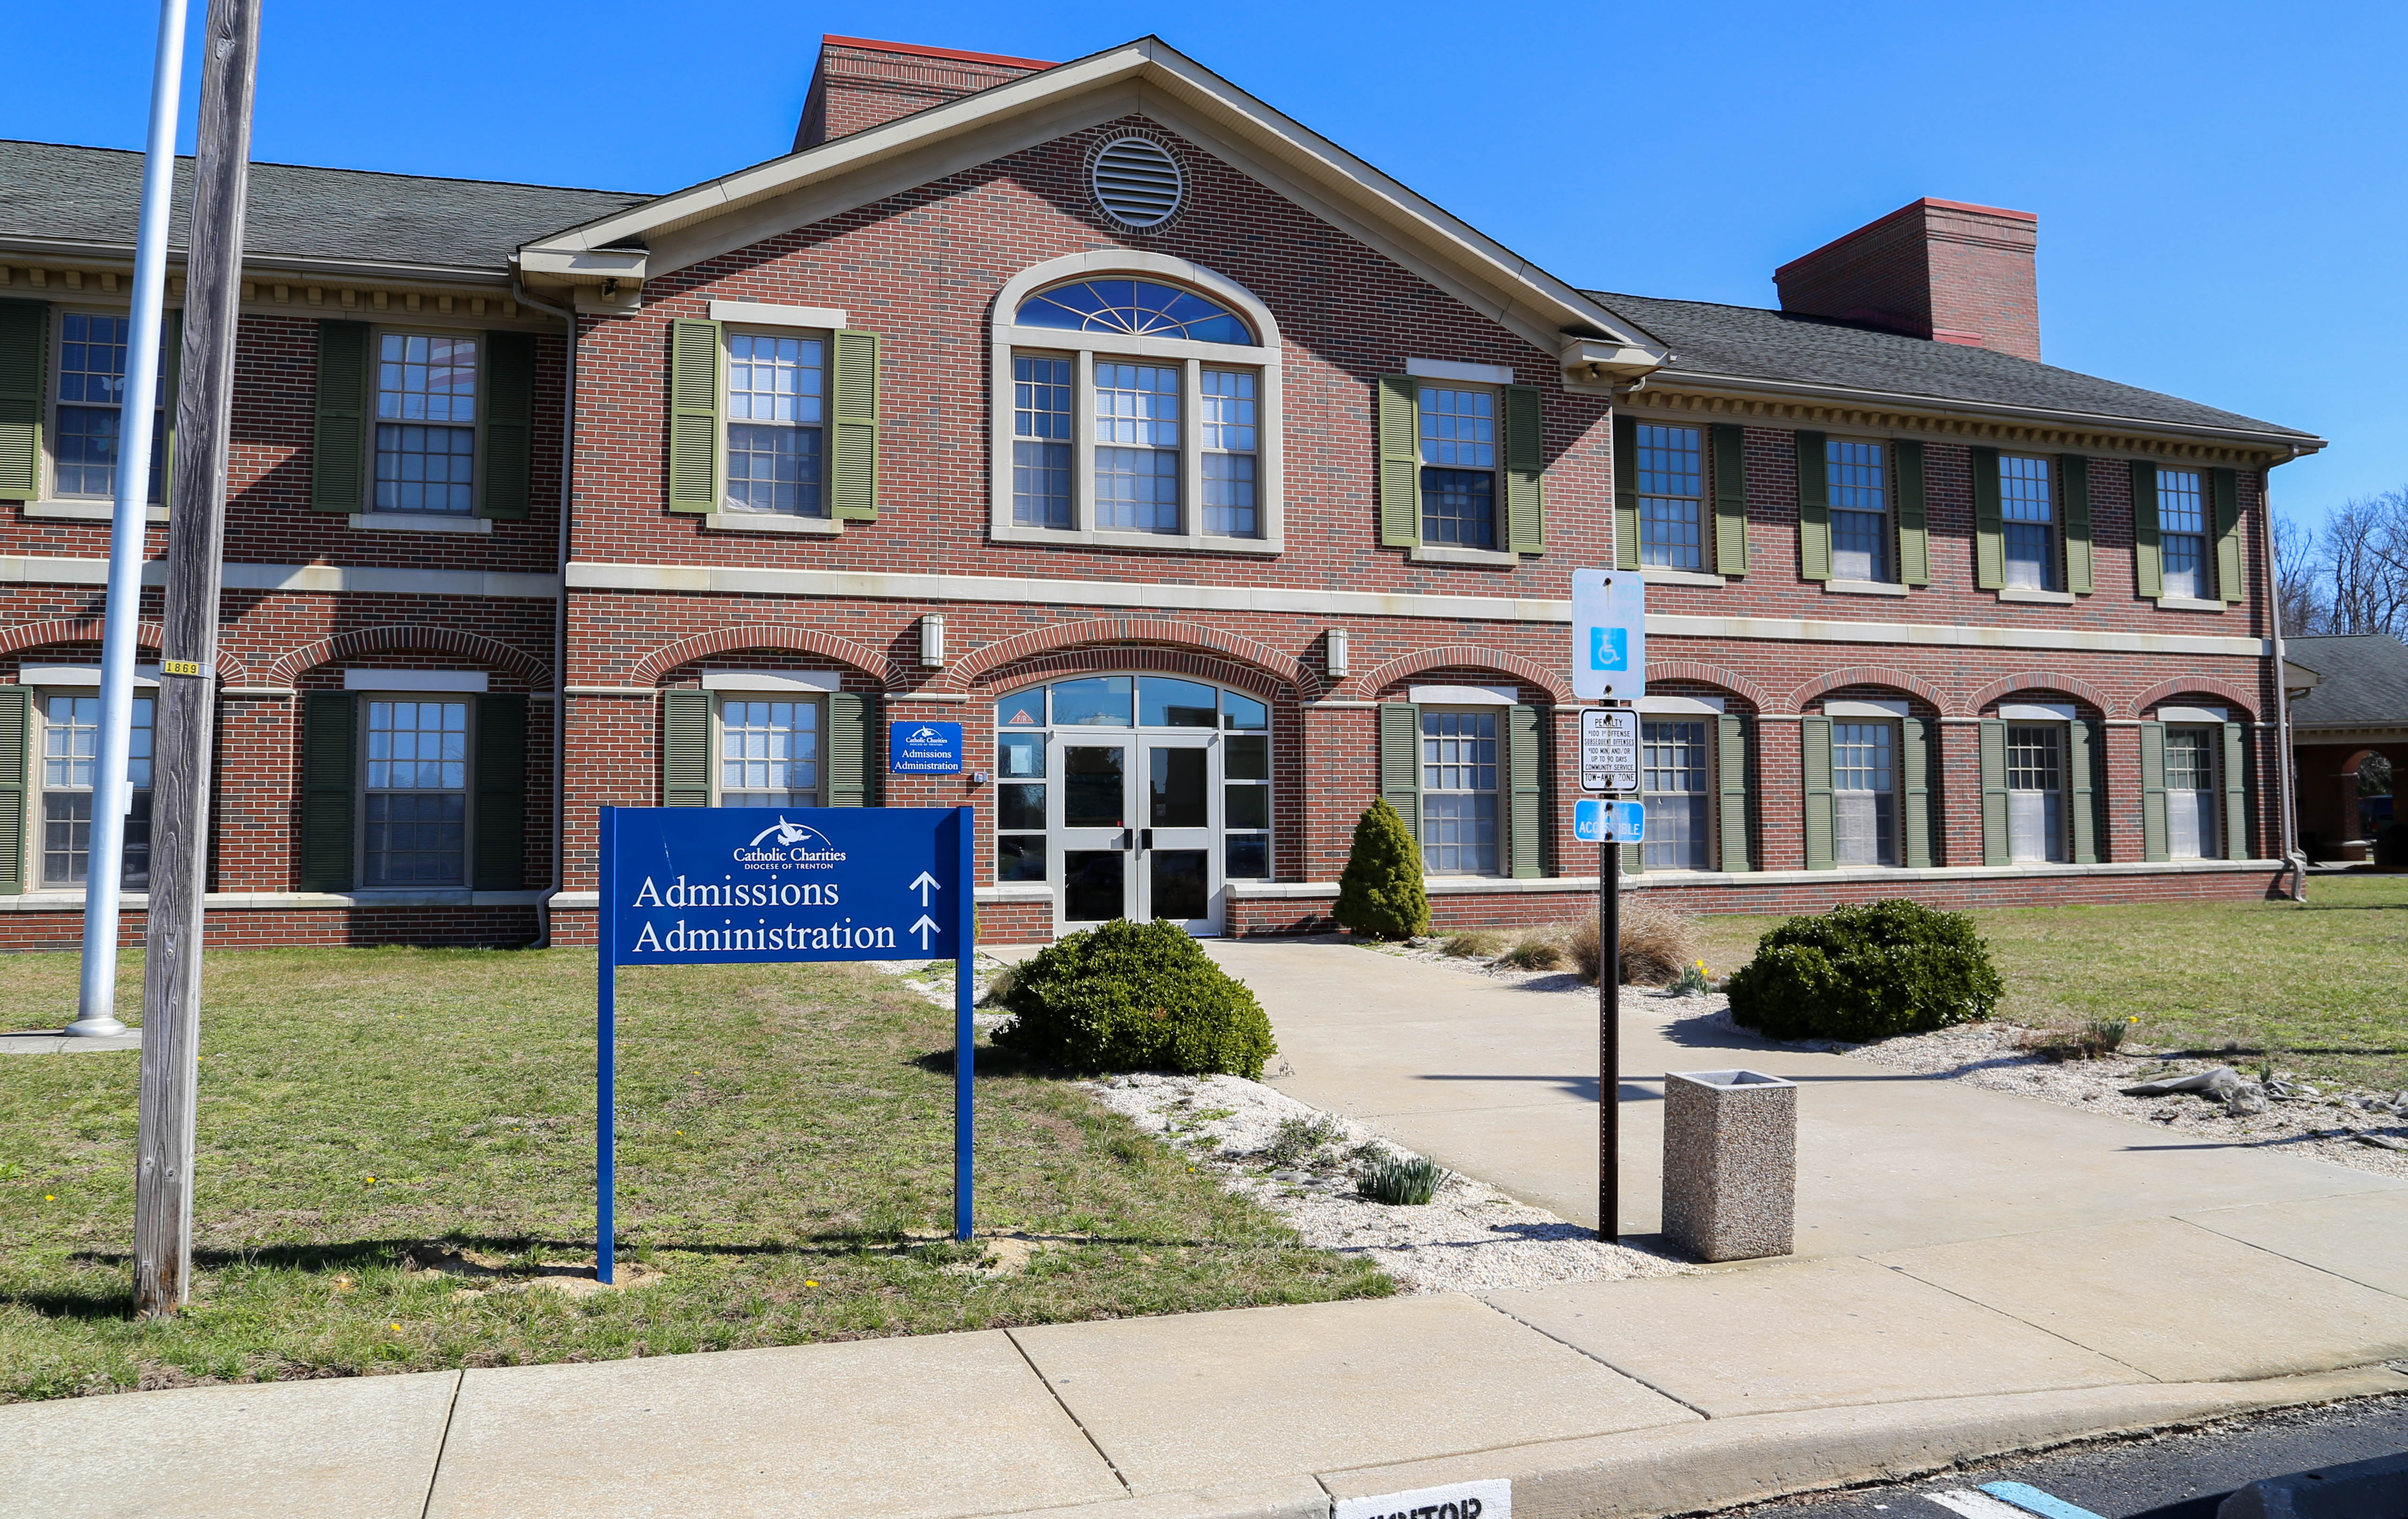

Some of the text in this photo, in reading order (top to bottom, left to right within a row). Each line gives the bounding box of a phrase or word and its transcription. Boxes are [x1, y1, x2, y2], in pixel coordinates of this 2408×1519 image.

[167, 663, 197, 673] 1869
[901, 749, 952, 758] Admissions
[894, 761, 958, 770] Administration
[1579, 821, 1640, 835] ACCSSIBLE
[734, 847, 846, 861] Catholic Charities
[633, 875, 839, 907] Admissions
[632, 918, 896, 952] Administration
